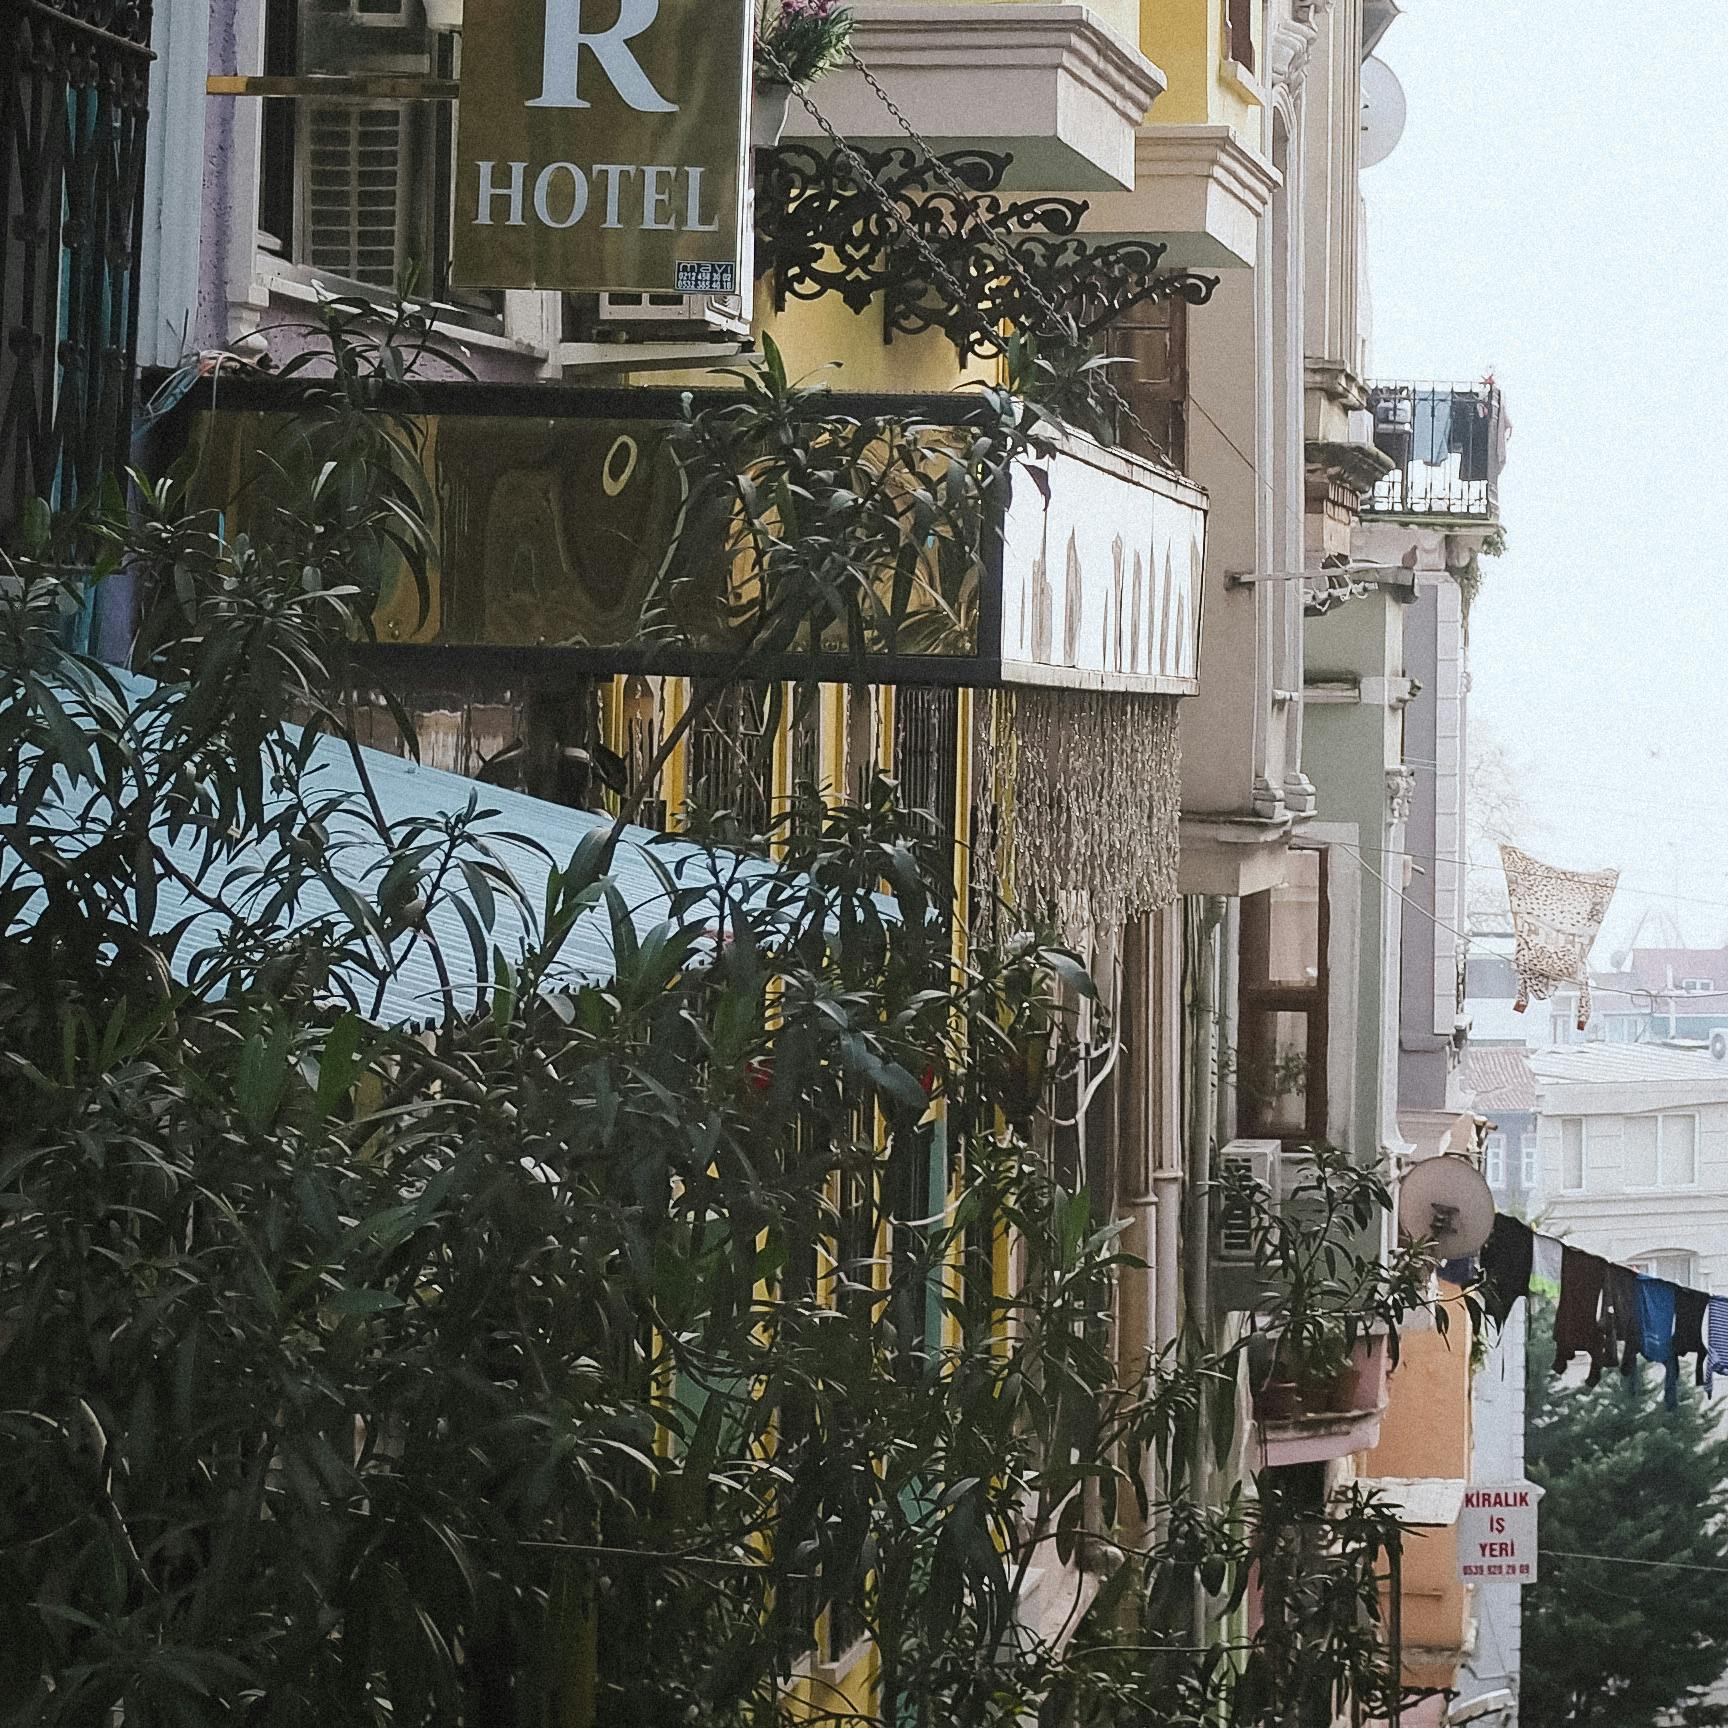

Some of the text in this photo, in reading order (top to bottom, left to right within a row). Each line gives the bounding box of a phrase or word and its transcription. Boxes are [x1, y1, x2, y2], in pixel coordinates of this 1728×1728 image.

[472, 161, 720, 232] HOTEL
[1465, 1490, 1529, 1508] KİRALIK
[1479, 1538, 1515, 1558] YERİ
